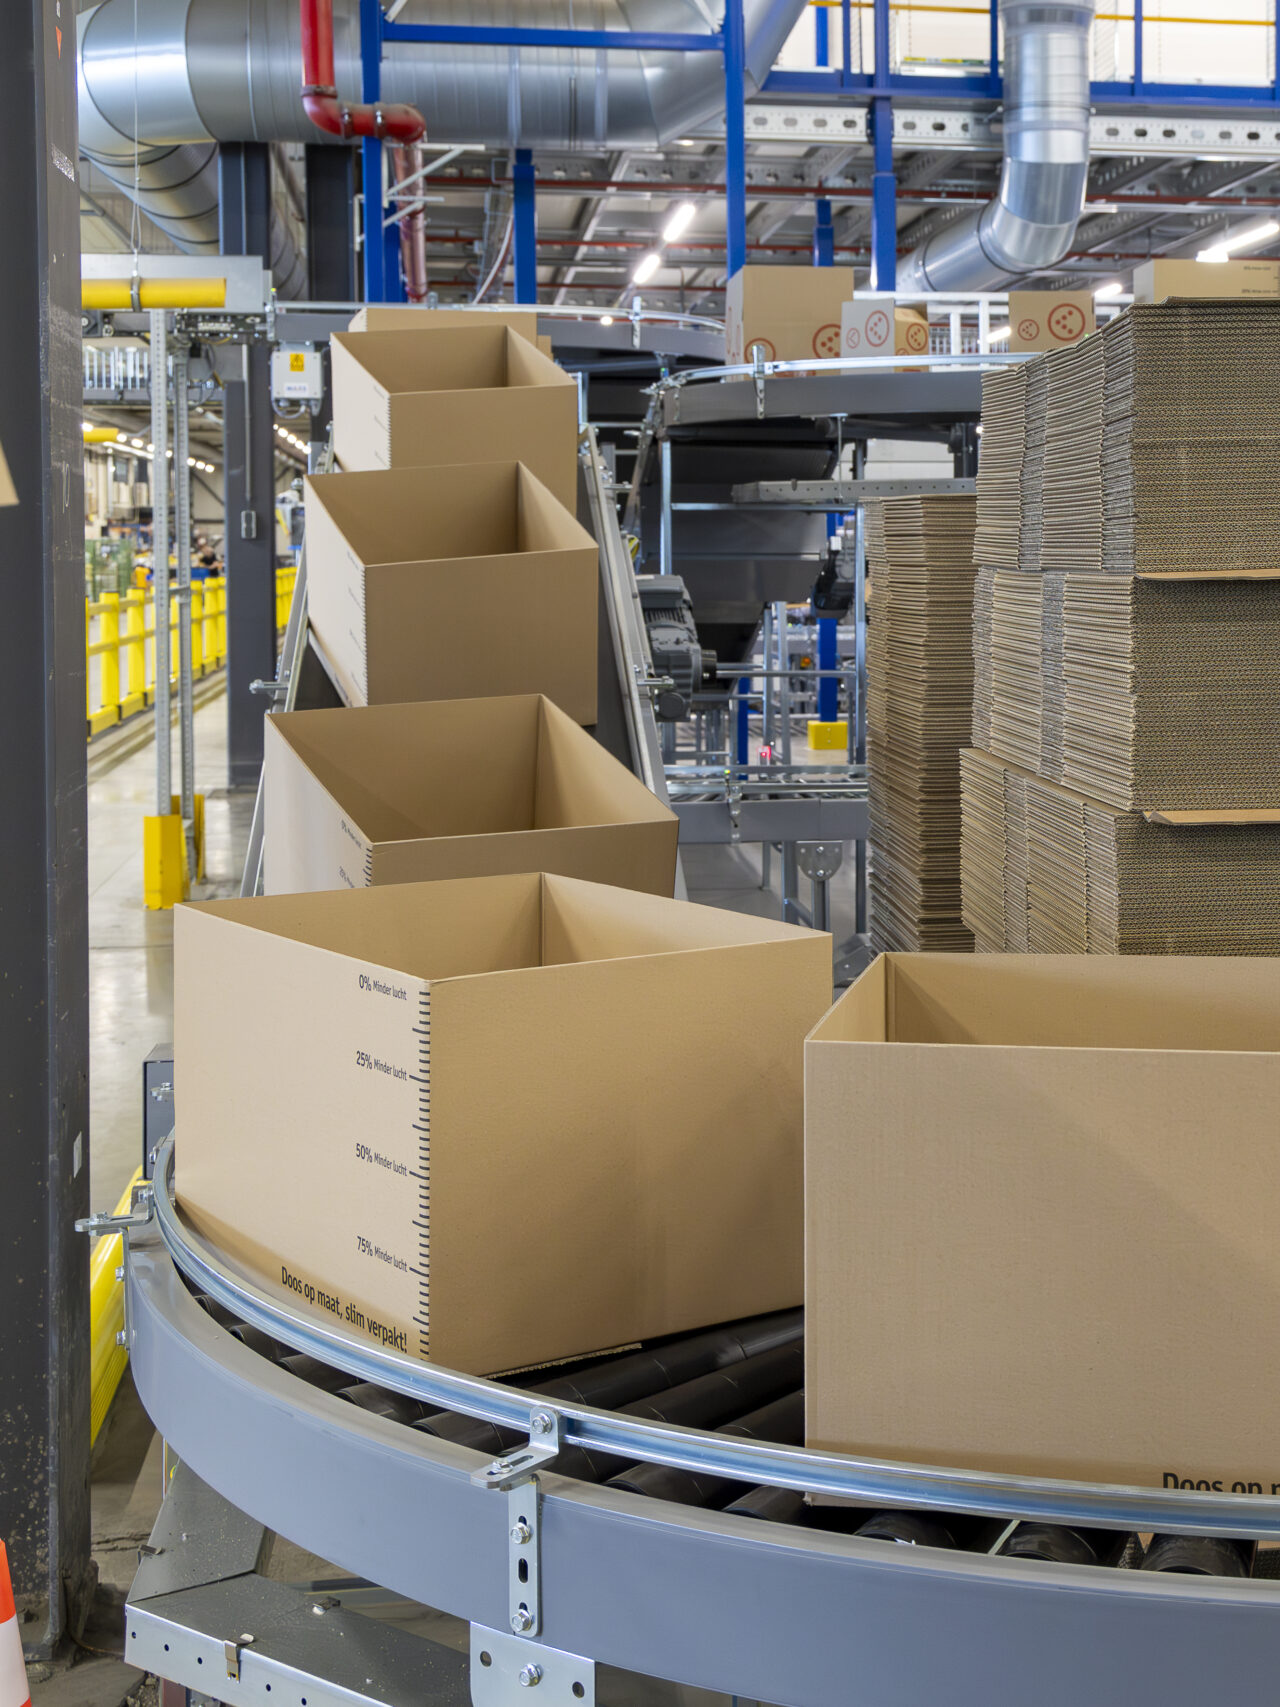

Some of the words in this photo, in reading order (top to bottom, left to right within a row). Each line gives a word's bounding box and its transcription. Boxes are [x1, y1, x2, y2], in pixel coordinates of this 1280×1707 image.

[358, 973, 372, 991] 0%
[373, 980, 392, 996] Minder
[392, 985, 408, 1000] lucht
[356, 1050, 373, 1070] 25%
[373, 1058, 392, 1075] Minder
[392, 1065, 408, 1081] lucht
[355, 1142, 373, 1164] 50%
[373, 1151, 393, 1170] Minder
[392, 1160, 408, 1177] lucht
[356, 1235, 374, 1257] 75%
[374, 1245, 393, 1265] Minder
[393, 1255, 408, 1273] lucht
[281, 1265, 303, 1295] Doos
[303, 1283, 316, 1305] op
[316, 1289, 343, 1320] maat,
[345, 1302, 366, 1330] slim
[366, 1316, 408, 1354] verpakt!
[1162, 1471, 1224, 1493] Doos
